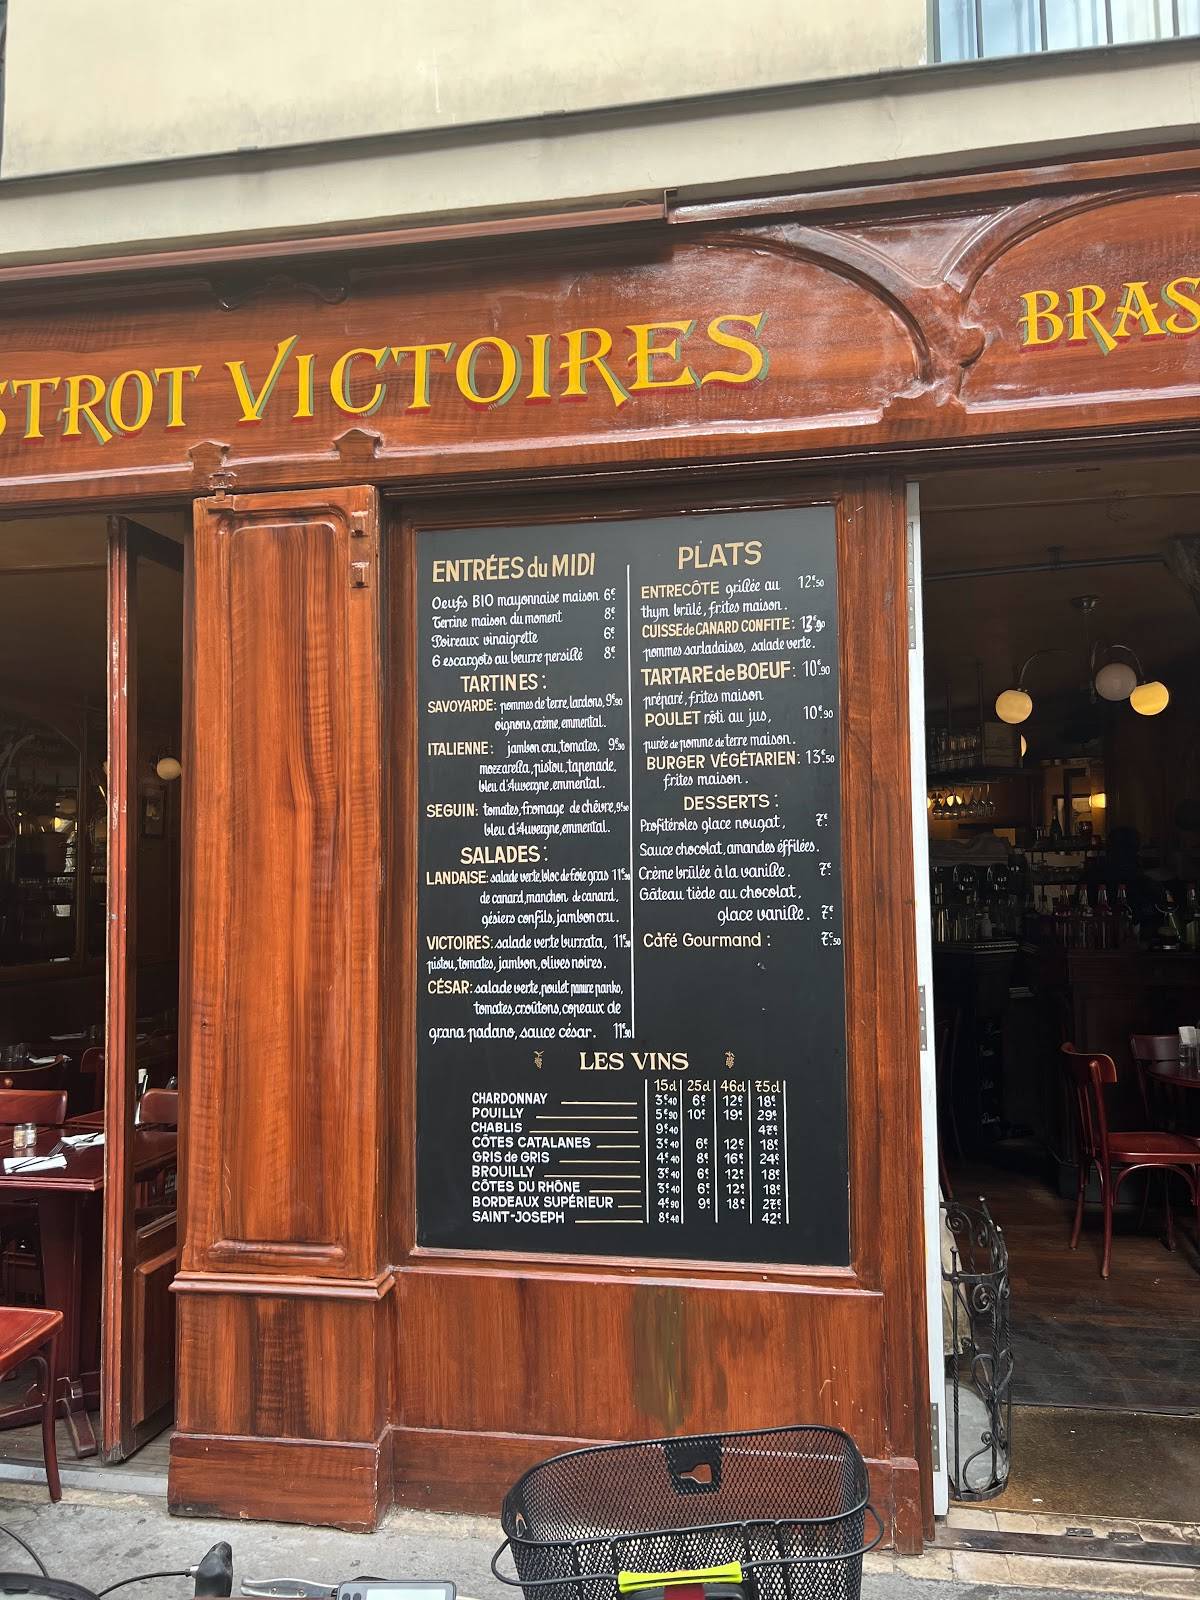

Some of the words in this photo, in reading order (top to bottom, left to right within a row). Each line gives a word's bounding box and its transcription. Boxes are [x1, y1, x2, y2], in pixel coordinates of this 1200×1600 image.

[1017, 275, 1200, 355] BRAS
[225, 312, 767, 421] VICTOIRES
[679, 541, 762, 569] PLATS
[433, 554, 524, 582] ENTRÉES
[528, 556, 547, 577] du
[552, 553, 595, 577] MIDI
[642, 580, 719, 599] ENTRECÔTE
[726, 579, 760, 599] grillée
[765, 581, 780, 591] au
[432, 595, 468, 610] Oeufs
[473, 594, 493, 607] BIO
[498, 591, 559, 610] mayonnaise
[563, 590, 600, 602] maison
[432, 615, 468, 629] Terrine
[472, 615, 507, 627] maison
[510, 613, 523, 624] du
[525, 610, 563, 624] moment
[640, 605, 670, 622] thym
[708, 601, 739, 618] frites
[642, 623, 684, 638] CUISSE
[684, 623, 694, 636] de
[696, 621, 739, 635] CANARD
[431, 635, 479, 648] Poireaux
[483, 631, 538, 649] vinaigrette
[432, 655, 440, 667] 6
[443, 652, 493, 671] escargots
[495, 655, 509, 664] au
[511, 647, 542, 664] beurre
[544, 647, 583, 665] persillé
[643, 646, 682, 662] pommes
[683, 641, 746, 655] sarladaises,
[751, 638, 784, 651] salade
[641, 665, 713, 686] TARTARE
[715, 665, 734, 681] de
[737, 661, 796, 680] BOEUF:
[428, 700, 497, 713] SAVOYARDE:
[500, 701, 533, 714] pommes
[535, 697, 547, 709] de
[689, 690, 718, 707] frites
[721, 689, 764, 702] maison
[645, 711, 700, 727] POULET
[704, 710, 725, 724] rôti
[728, 712, 744, 723] au
[746, 708, 771, 727] jus,
[507, 740, 540, 757] jambon
[643, 737, 668, 754] purée
[670, 740, 678, 748] de
[679, 738, 714, 752] pomme
[715, 738, 724, 747] de
[724, 734, 748, 746] terre
[647, 755, 705, 770] BURGER
[711, 751, 800, 767] VÉGÉTARIEN:
[663, 773, 693, 791] frites
[427, 803, 478, 817] SEGUIN:
[702, 817, 731, 834] glace
[735, 815, 785, 832] nougat,
[640, 843, 673, 856] Sauce
[427, 871, 488, 885] LANDAISE:
[490, 870, 518, 883] salade
[639, 866, 673, 880] Crème
[676, 865, 711, 879] brûlée
[714, 865, 723, 877] à
[725, 865, 739, 877] la
[640, 887, 684, 900] Gâteau
[686, 886, 715, 900] tiède
[719, 889, 737, 899] au
[740, 884, 801, 899] chocolat,
[718, 907, 753, 926] glace
[427, 935, 493, 950] VICTOIRES:
[494, 935, 531, 949] salade
[534, 934, 559, 948] verte
[561, 934, 607, 949] burrata,
[643, 932, 677, 947] Café
[428, 978, 472, 994] CÉSAR:
[474, 980, 512, 993] salade
[429, 1028, 466, 1044] grana
[467, 1023, 517, 1042] padano,
[519, 1027, 555, 1038] sauce
[580, 1052, 624, 1070] LES
[631, 1053, 689, 1070] VINS
[472, 1092, 547, 1104] CHARDONNAY
[473, 1107, 524, 1118] POUILLY
[471, 1122, 522, 1133] CHABLIS
[472, 1136, 513, 1148] CÔTES
[518, 1137, 591, 1148] CATALANES
[472, 1152, 502, 1163] GRIS
[504, 1152, 518, 1163] de
[521, 1152, 549, 1163] GRIS
[472, 1166, 534, 1177] BROUILLY
[472, 1180, 514, 1192] CÔTES
[519, 1182, 535, 1192] DU
[538, 1180, 580, 1192] RHÔNE
[473, 1196, 539, 1207] BORDEAUX
[544, 1194, 613, 1208] SUPÉRIEUR
[472, 1211, 564, 1223] SAINT-JOSEPH
